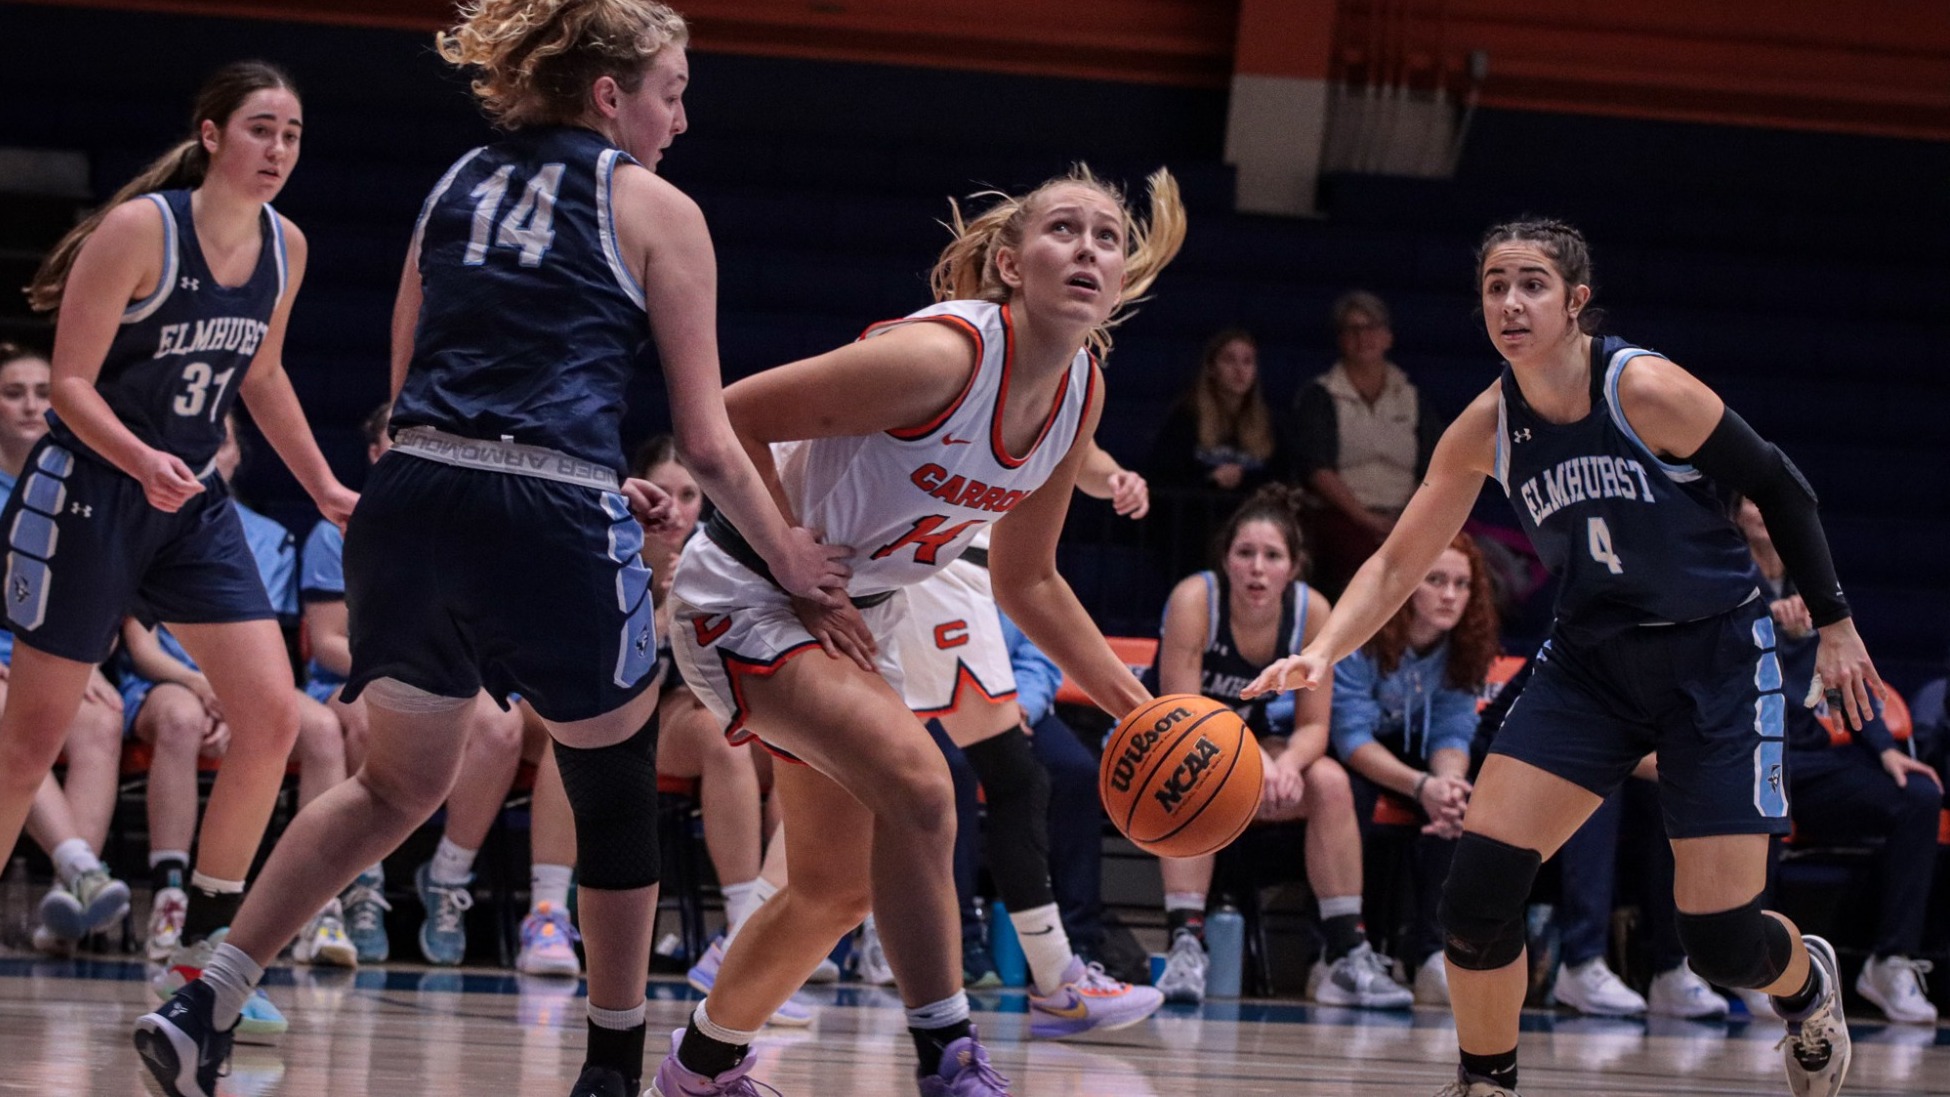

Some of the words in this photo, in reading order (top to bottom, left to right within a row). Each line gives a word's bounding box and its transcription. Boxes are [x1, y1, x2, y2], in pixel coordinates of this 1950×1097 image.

[463, 163, 566, 268] 14
[173, 361, 236, 423] 31
[557, 456, 618, 485] NDER
[910, 462, 1031, 513] CARRO
[1520, 455, 1656, 528] ELMHURST
[870, 513, 987, 566] 14
[1587, 516, 1625, 575] 4
[934, 618, 970, 651] C
[1111, 707, 1193, 792] Wilson
[1154, 735, 1222, 815] NCAA
